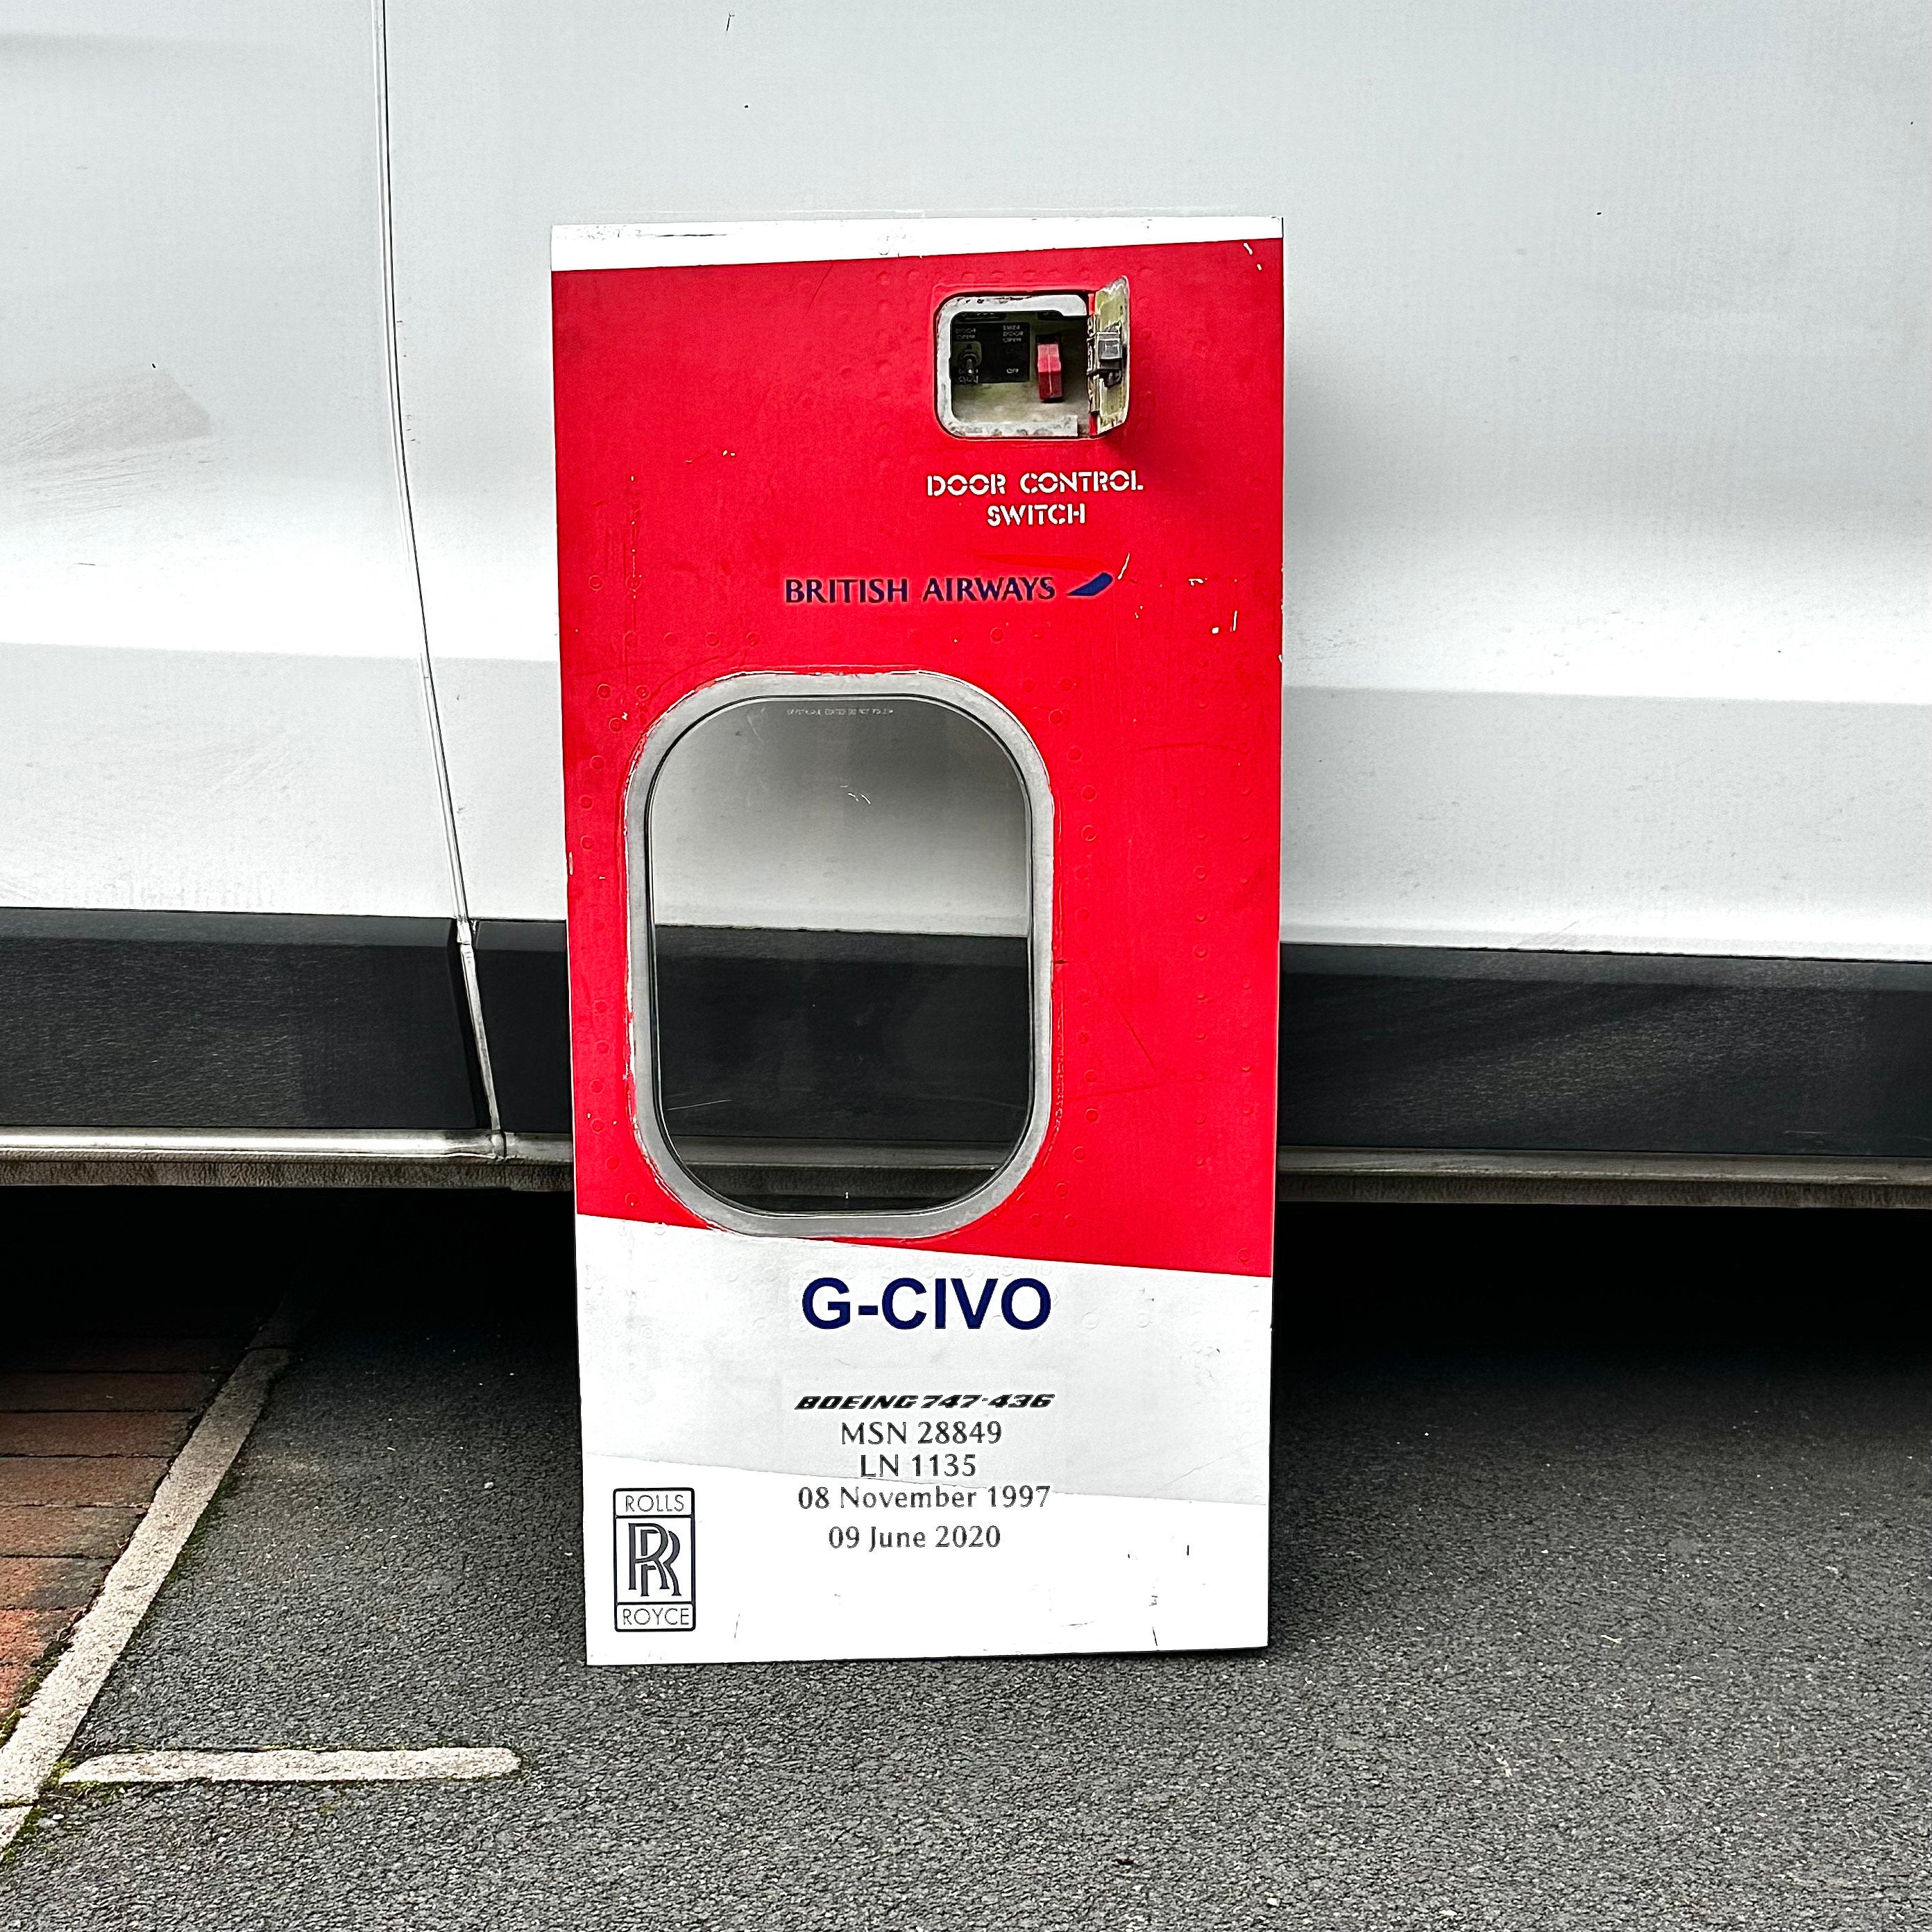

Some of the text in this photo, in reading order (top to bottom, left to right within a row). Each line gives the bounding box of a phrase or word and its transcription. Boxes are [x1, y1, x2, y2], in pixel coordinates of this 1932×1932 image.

[927, 470, 1144, 496] DOOR CONTROL
[987, 503, 1085, 527] SWITCH
[786, 577, 1056, 604] BRITISH AIRWAYS
[802, 1277, 1051, 1330] G-CIVO
[795, 1393, 1056, 1410] BOEING 747-436
[842, 1421, 1002, 1445] MSN 28849
[861, 1453, 976, 1477] LN 1135
[626, 1494, 684, 1512] ROLLS
[798, 1484, 1051, 1509] 08 November 1997
[829, 1525, 1001, 1552] 09 June 2020
[622, 1607, 689, 1625] ROYCE
